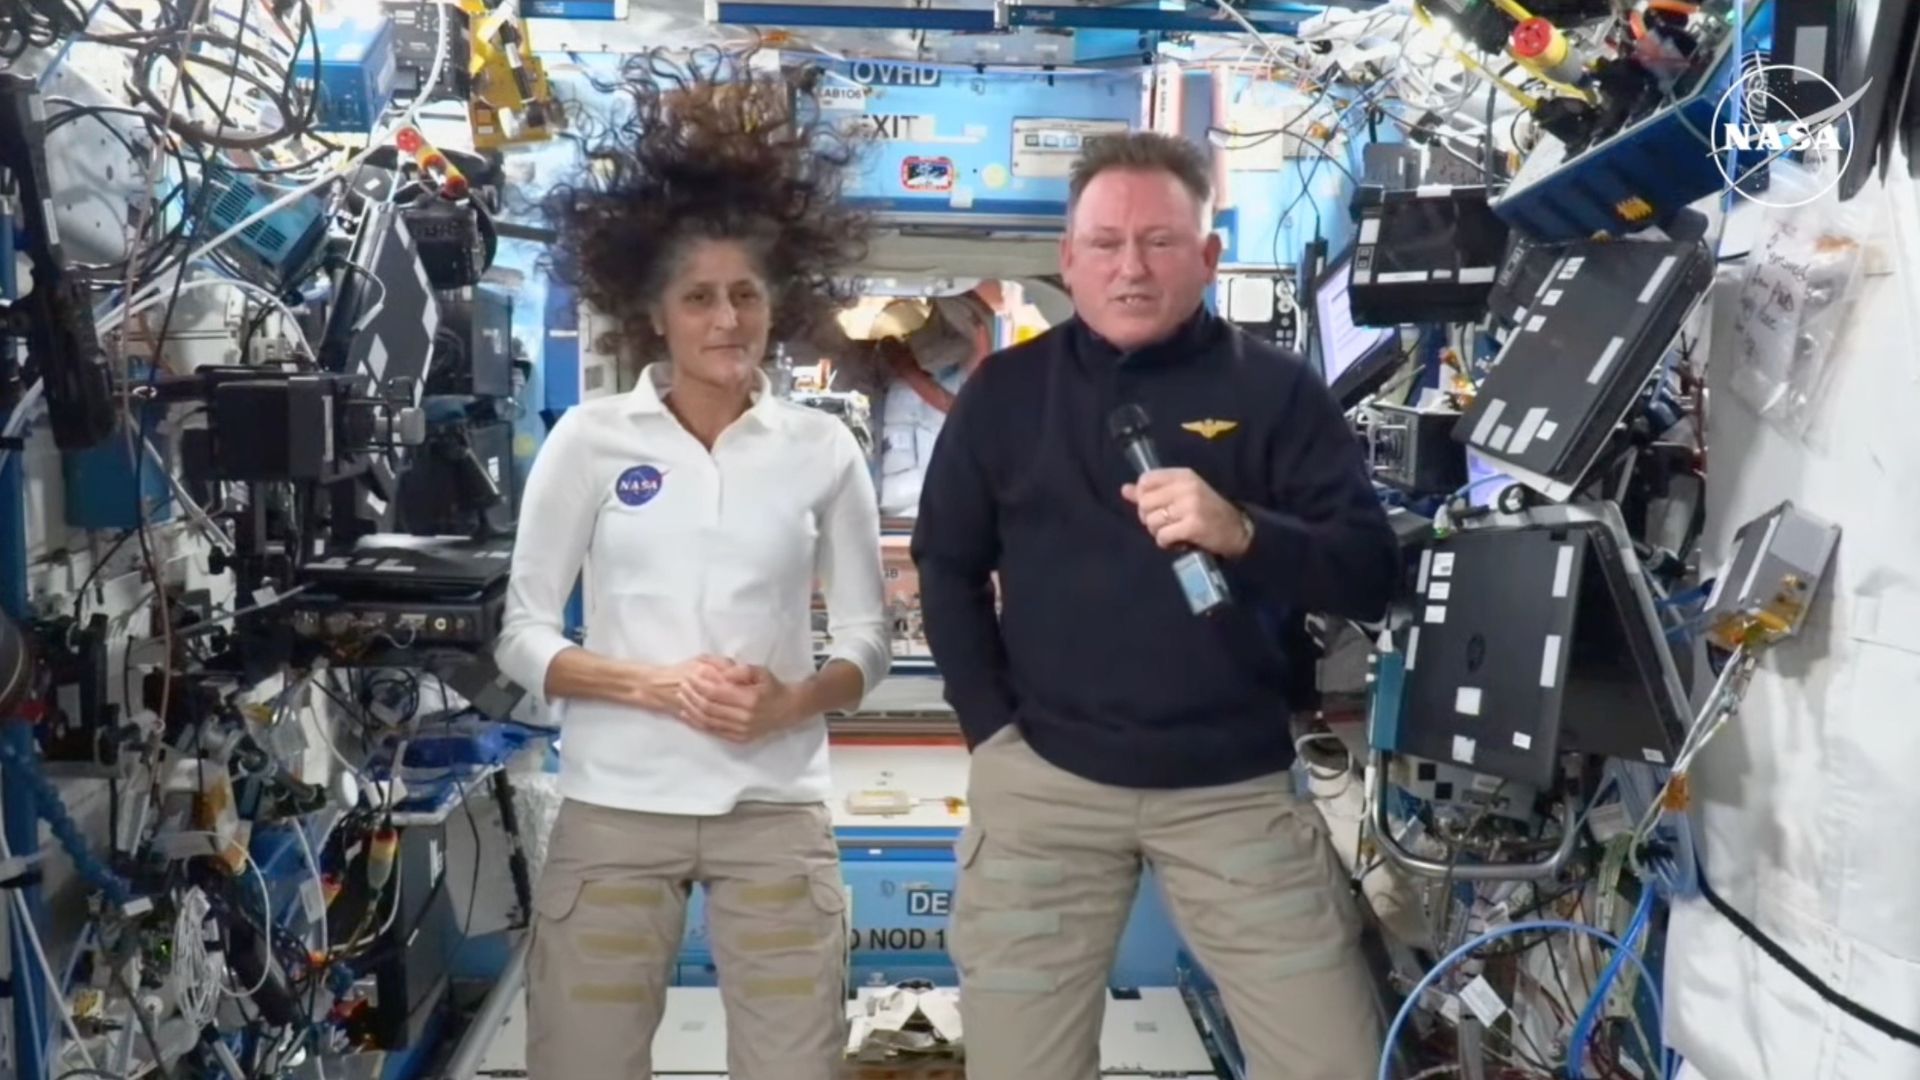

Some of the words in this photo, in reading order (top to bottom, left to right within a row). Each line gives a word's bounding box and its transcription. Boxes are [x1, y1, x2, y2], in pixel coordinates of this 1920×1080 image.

[853, 61, 939, 86] OVHD
[869, 928, 926, 950] NOD
[935, 928, 945, 950] 1
